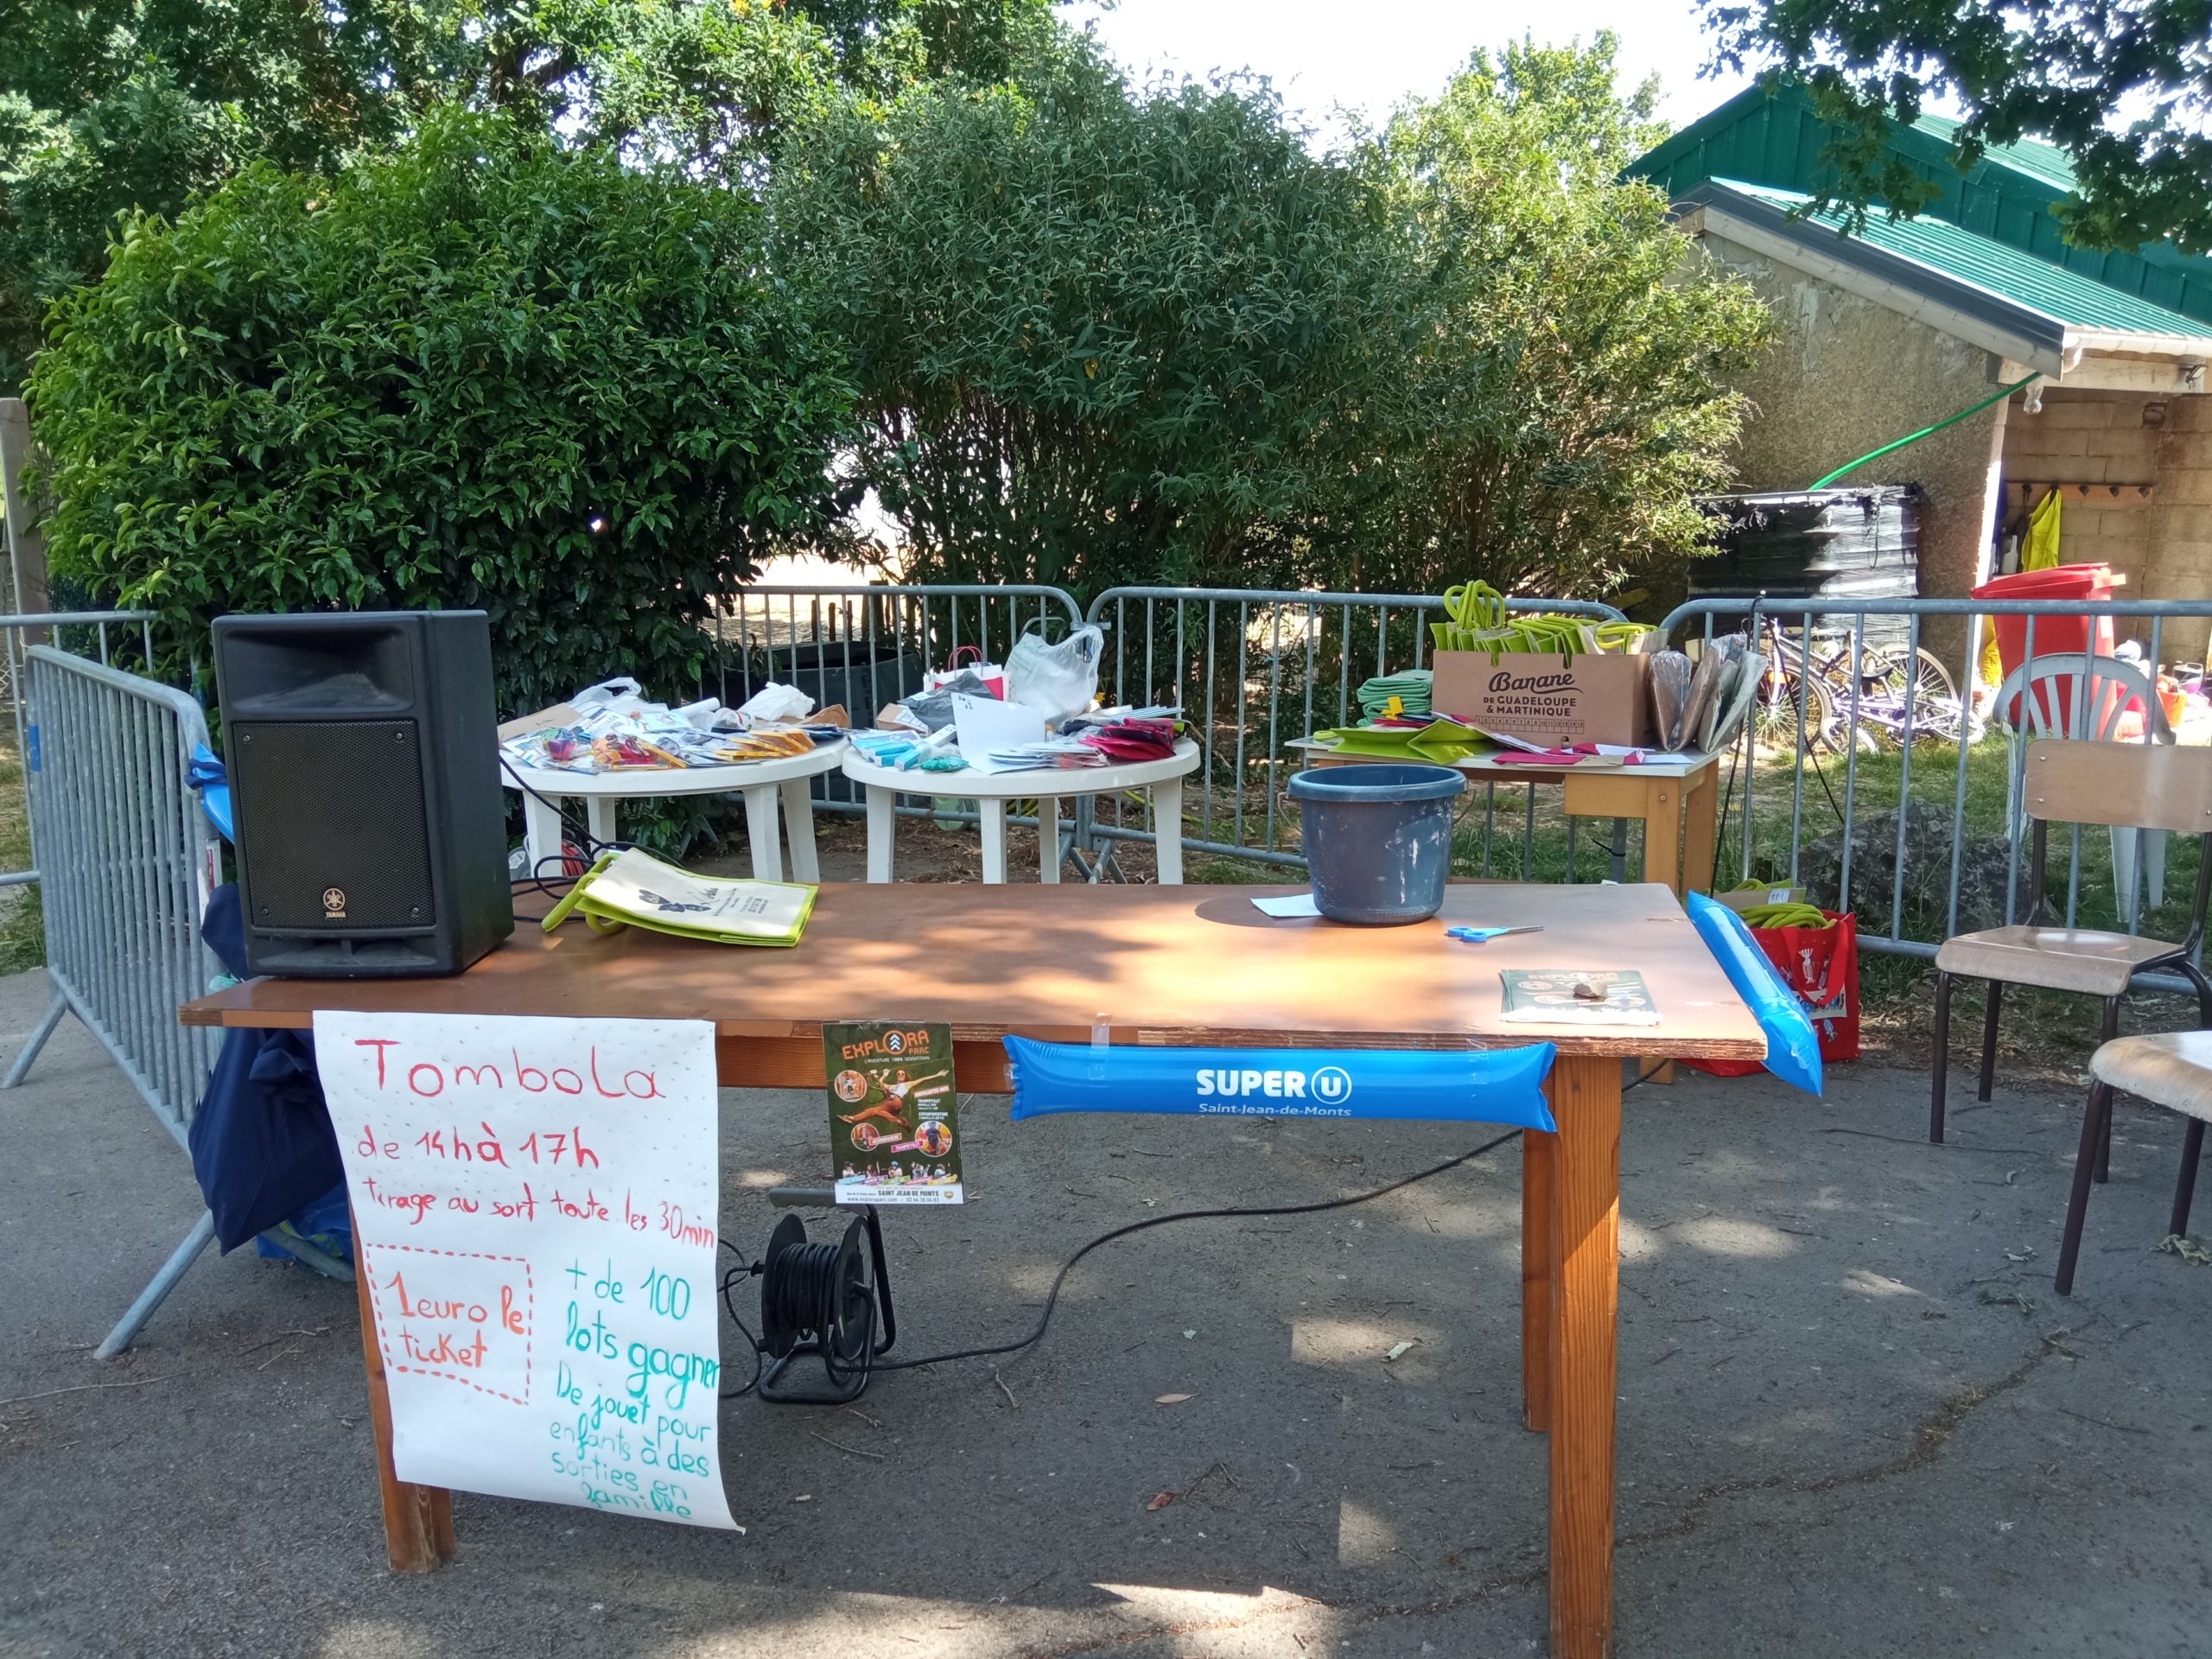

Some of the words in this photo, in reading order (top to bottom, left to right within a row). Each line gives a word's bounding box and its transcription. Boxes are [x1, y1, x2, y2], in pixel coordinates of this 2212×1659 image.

[1489, 671, 1583, 694] Banane
[1497, 696, 1576, 707] GUADELOUPE
[1486, 705, 1493, 714] &
[1497, 706, 1571, 716] MARTINIQUE
[842, 1029, 930, 1060] EXPLORA
[908, 1046, 930, 1055] PARC
[355, 1039, 666, 1099] Tombola
[1196, 1069, 1306, 1097] SUPER
[1198, 1103, 1352, 1116] Saint-Jean-de-Monts
[358, 1126, 400, 1160] de
[518, 1127, 599, 1169] 17h
[362, 1177, 437, 1225] tirage
[448, 1197, 480, 1214] au
[493, 1183, 540, 1222] sort
[551, 1189, 609, 1221] toute
[626, 1188, 648, 1230] les
[501, 1285, 525, 1334] le
[594, 1257, 625, 1303] de
[640, 1266, 690, 1320] 100
[566, 1300, 619, 1359] lots
[556, 1360, 582, 1406] De
[590, 1382, 651, 1430] jouet
[658, 1415, 712, 1449] pour
[550, 1413, 631, 1460] enfants
[640, 1436, 659, 1466] à
[667, 1439, 709, 1477] des
[551, 1452, 639, 1492] sorties
[653, 1479, 689, 1501] en
